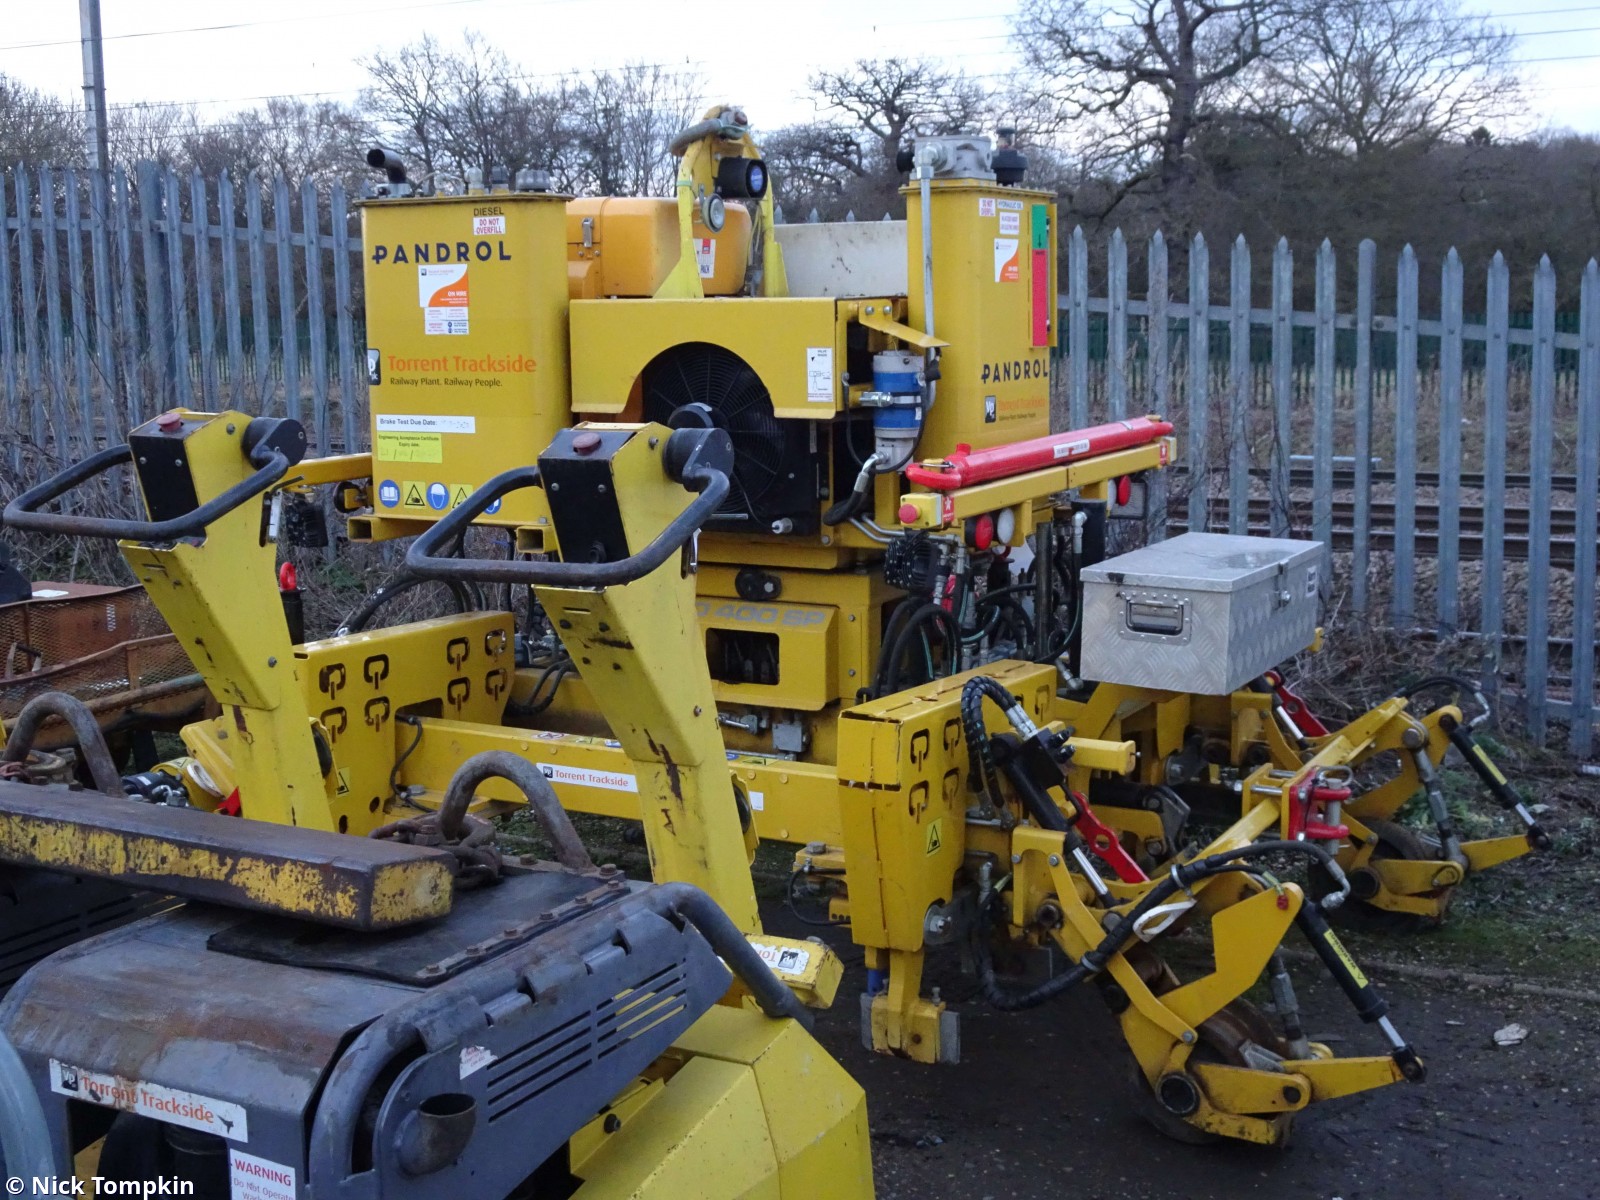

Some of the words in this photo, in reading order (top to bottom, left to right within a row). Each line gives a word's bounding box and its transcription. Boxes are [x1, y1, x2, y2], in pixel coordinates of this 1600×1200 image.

[473, 206, 504, 216] DIESEL
[476, 226, 502, 235] OVERFILL
[479, 218, 488, 226] DO
[488, 217, 500, 226] NOT
[371, 240, 512, 265] PANDROL
[388, 355, 448, 372] Torrent
[453, 353, 537, 373] Trackside
[981, 359, 1048, 384] PANDROL
[390, 377, 418, 387] Railway
[421, 377, 442, 386] Plant.
[444, 377, 472, 388] Railway
[475, 377, 503, 388] People.
[714, 602, 778, 624] 400
[782, 609, 825, 627] SP
[555, 769, 586, 782] Torrent
[588, 774, 629, 787] Trackside
[81, 1076, 138, 1104] Torrent
[140, 1088, 214, 1124] Trackside
[234, 1158, 291, 1187] WARNING
[233, 1178, 244, 1188] Do
[246, 1182, 260, 1193] Not
